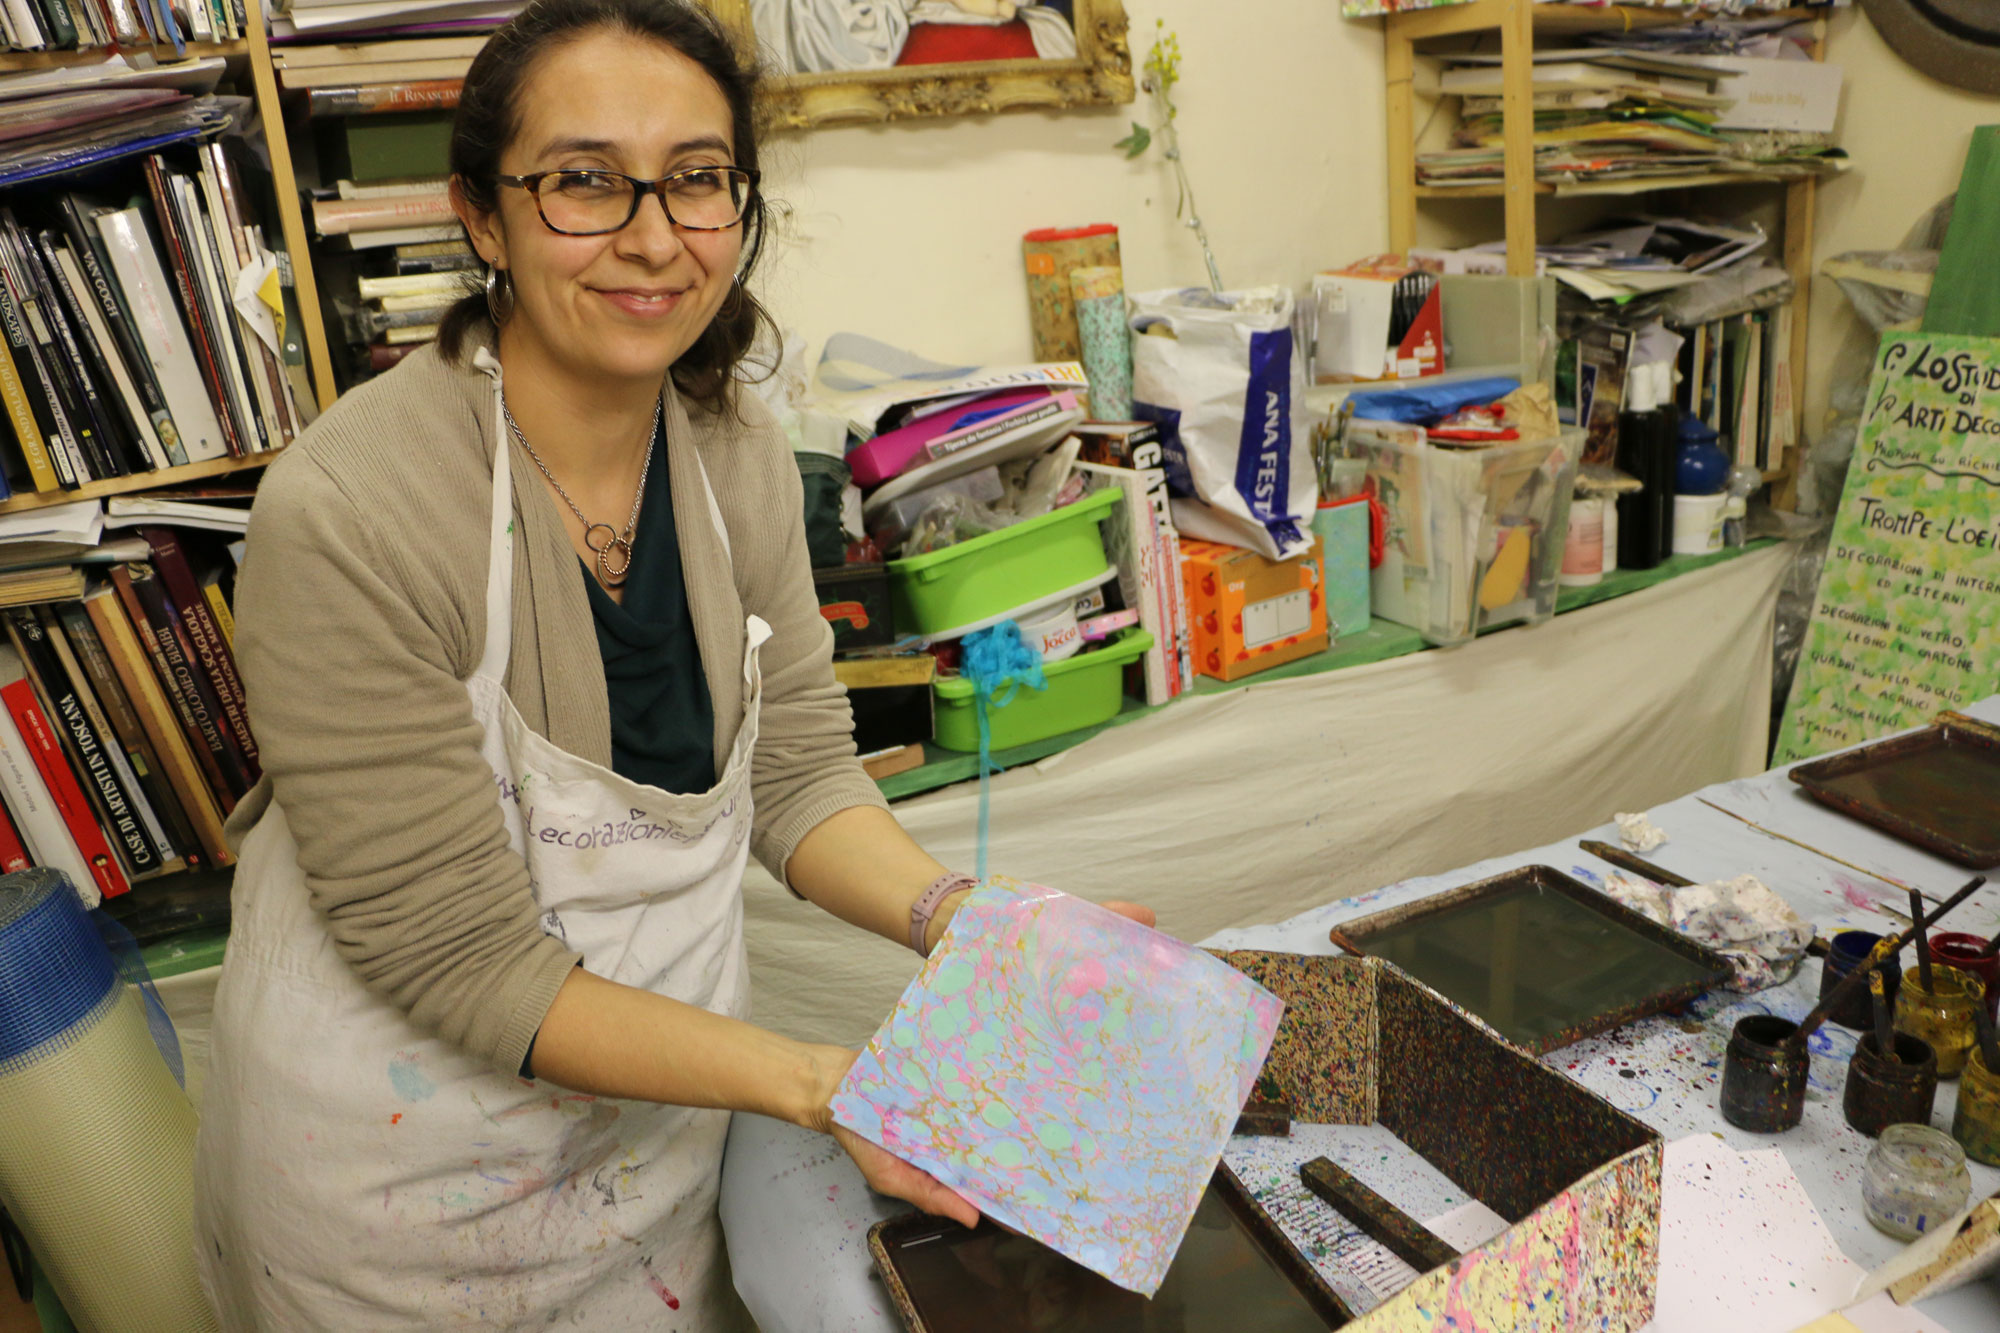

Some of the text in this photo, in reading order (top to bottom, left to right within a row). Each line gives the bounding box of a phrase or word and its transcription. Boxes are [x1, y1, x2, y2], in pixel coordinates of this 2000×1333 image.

[83, 250, 119, 318] VAN GOGH
[1904, 583, 1965, 606] ESTERNI
[182, 605, 217, 668] SCAGLIOLA
[195, 601, 219, 644] MARCHE
[217, 653, 245, 704] ROMAGNA
[1918, 649, 1974, 672] CARTONE
[156, 626, 225, 751] BARTOLOMEO BIMBI
[209, 668, 233, 704] DELLA
[60, 692, 95, 754] TOSCANA
[225, 703, 255, 751] MAESTRI
[86, 752, 105, 770] IN
[94, 766, 129, 816] ARTISTI
[117, 816, 136, 832] DI
[125, 832, 151, 864] CASE
